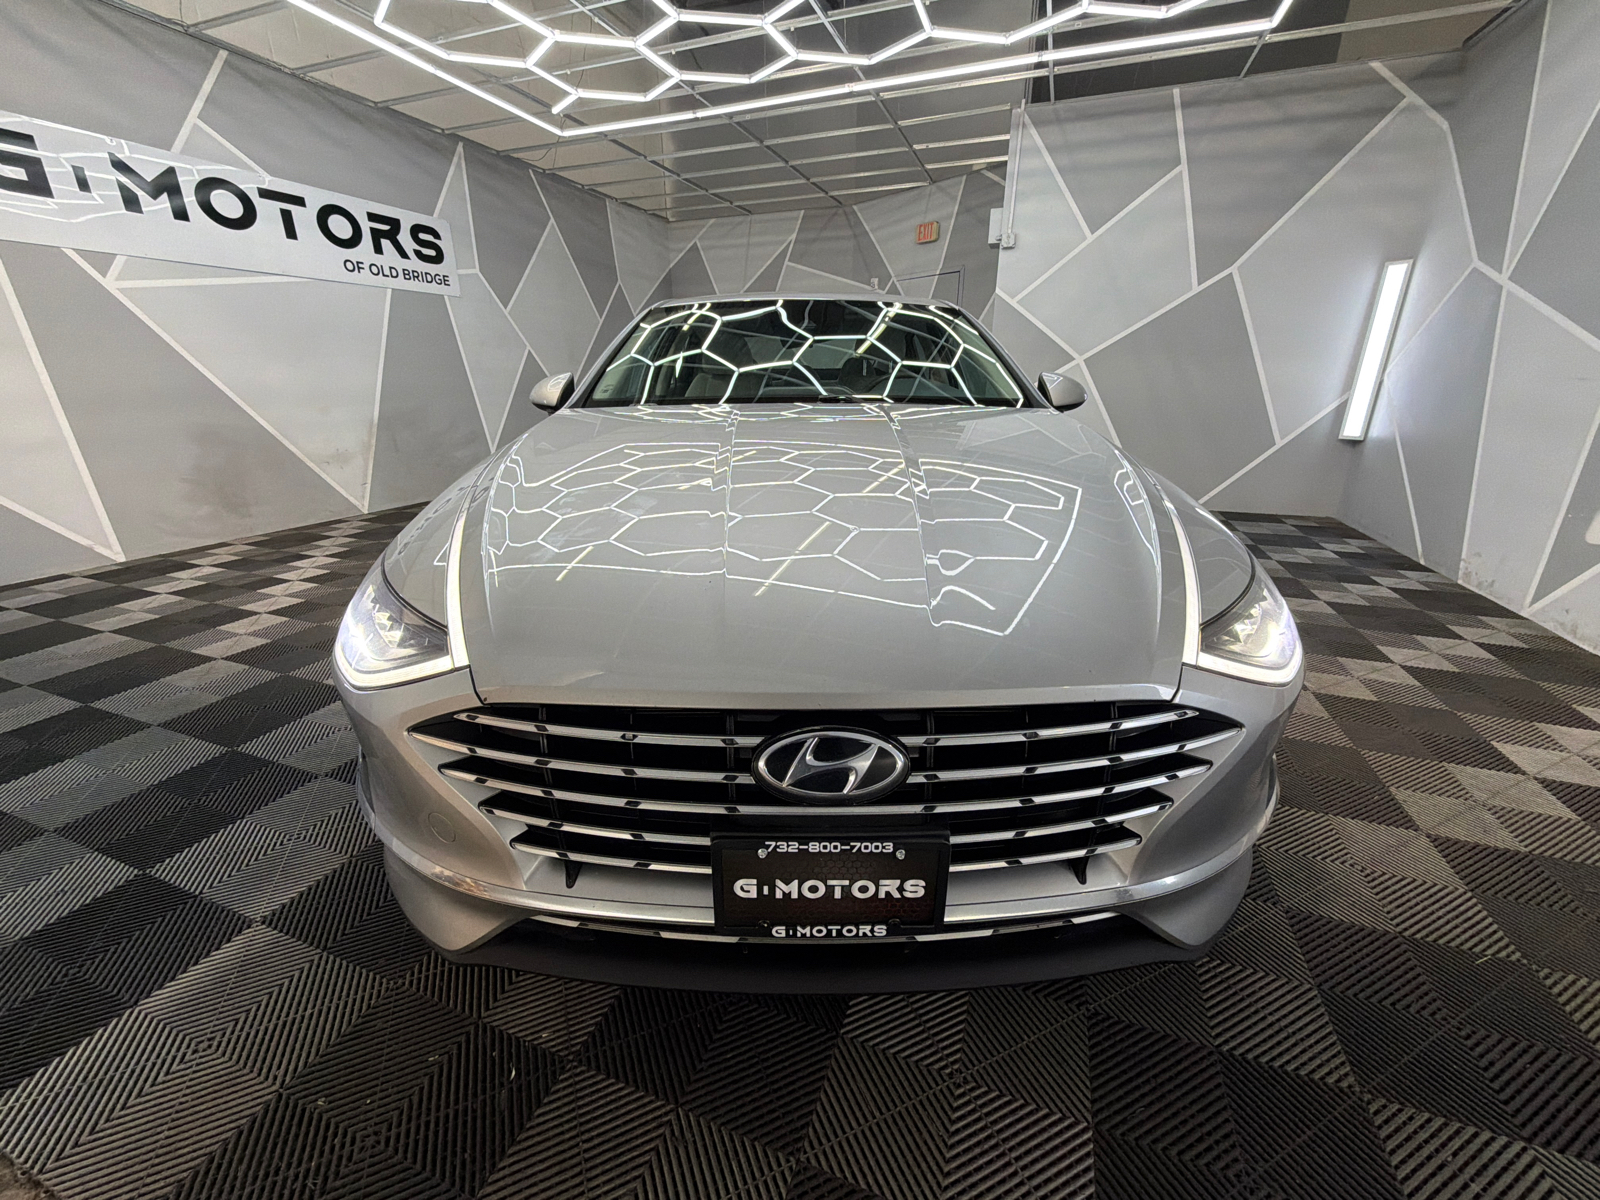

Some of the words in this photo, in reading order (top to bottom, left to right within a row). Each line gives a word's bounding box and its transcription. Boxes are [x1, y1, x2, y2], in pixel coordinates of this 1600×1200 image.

[917, 222, 934, 242] EXIT
[343, 259, 365, 274] OF
[368, 263, 399, 279] OLD
[402, 268, 451, 287] BRIDGE
[764, 841, 894, 853] 732-800-7003
